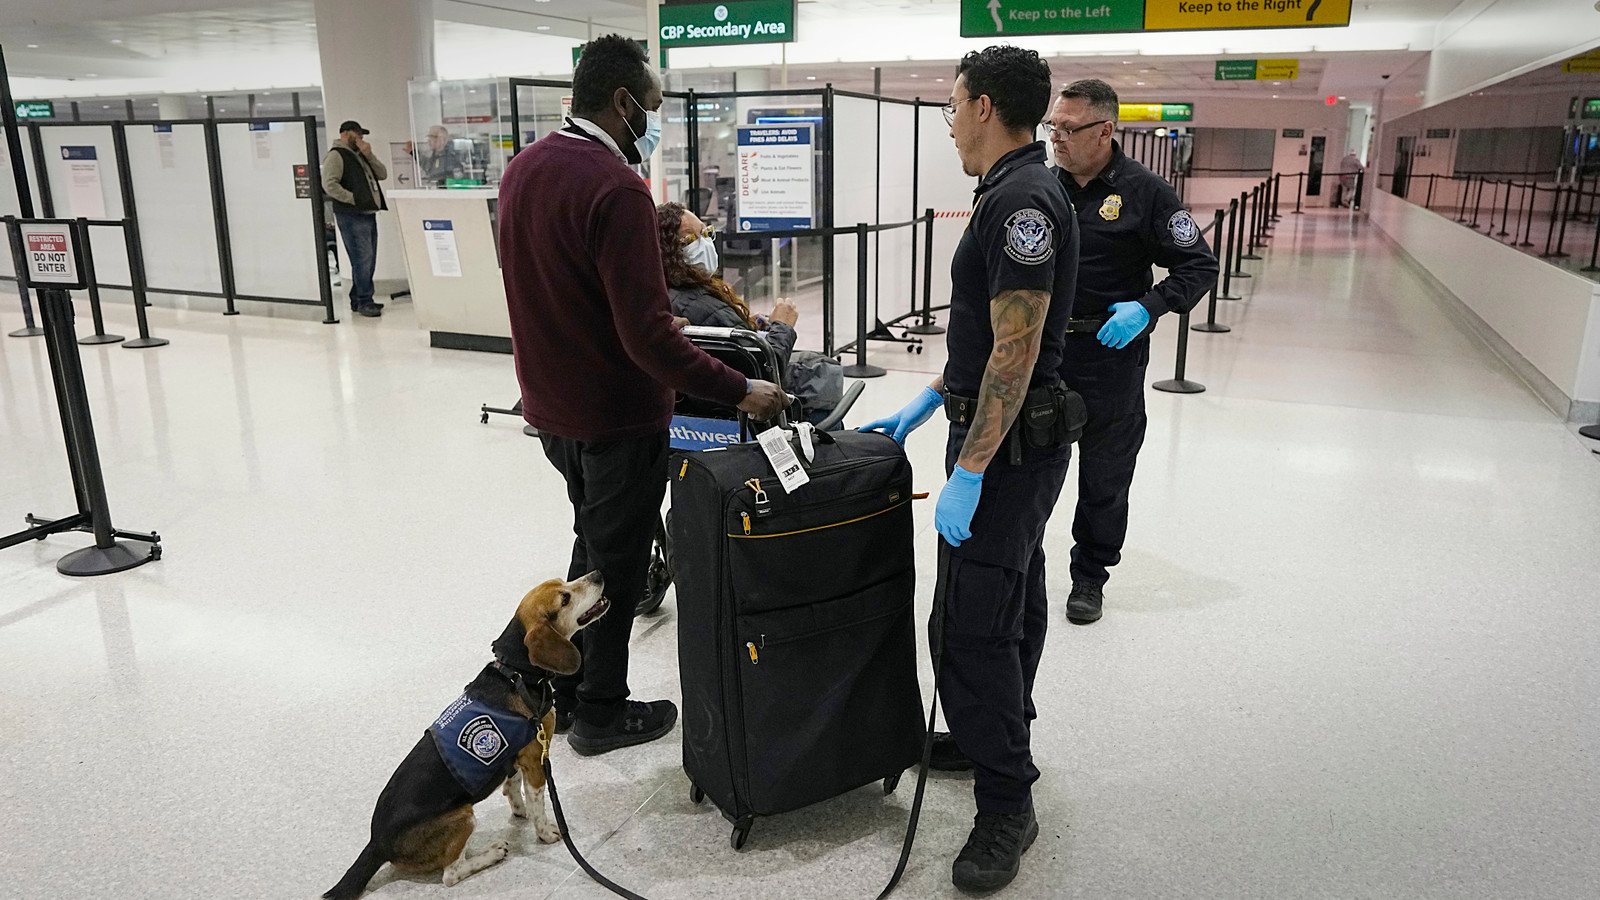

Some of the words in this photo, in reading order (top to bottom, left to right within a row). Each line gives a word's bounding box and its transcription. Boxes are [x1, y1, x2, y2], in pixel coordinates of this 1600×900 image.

[1009, 9, 1040, 22] Keep
[1044, 9, 1057, 19] to
[1061, 6, 1082, 18] the
[1085, 5, 1111, 18] Left
[1179, 2, 1213, 15] Keep
[1217, 1, 1232, 12] to
[1236, 0, 1259, 11] the
[1263, 0, 1301, 12] Right
[660, 25, 685, 40] CBP
[686, 21, 751, 39] Secondary
[753, 20, 786, 35] Area
[741, 152, 749, 196] DECLARE
[28, 235, 64, 243] RESTRICTED
[33, 252, 46, 262] DO
[48, 252, 66, 262] NOT
[37, 263, 66, 272] ENTER
[440, 698, 473, 730] Protecting
